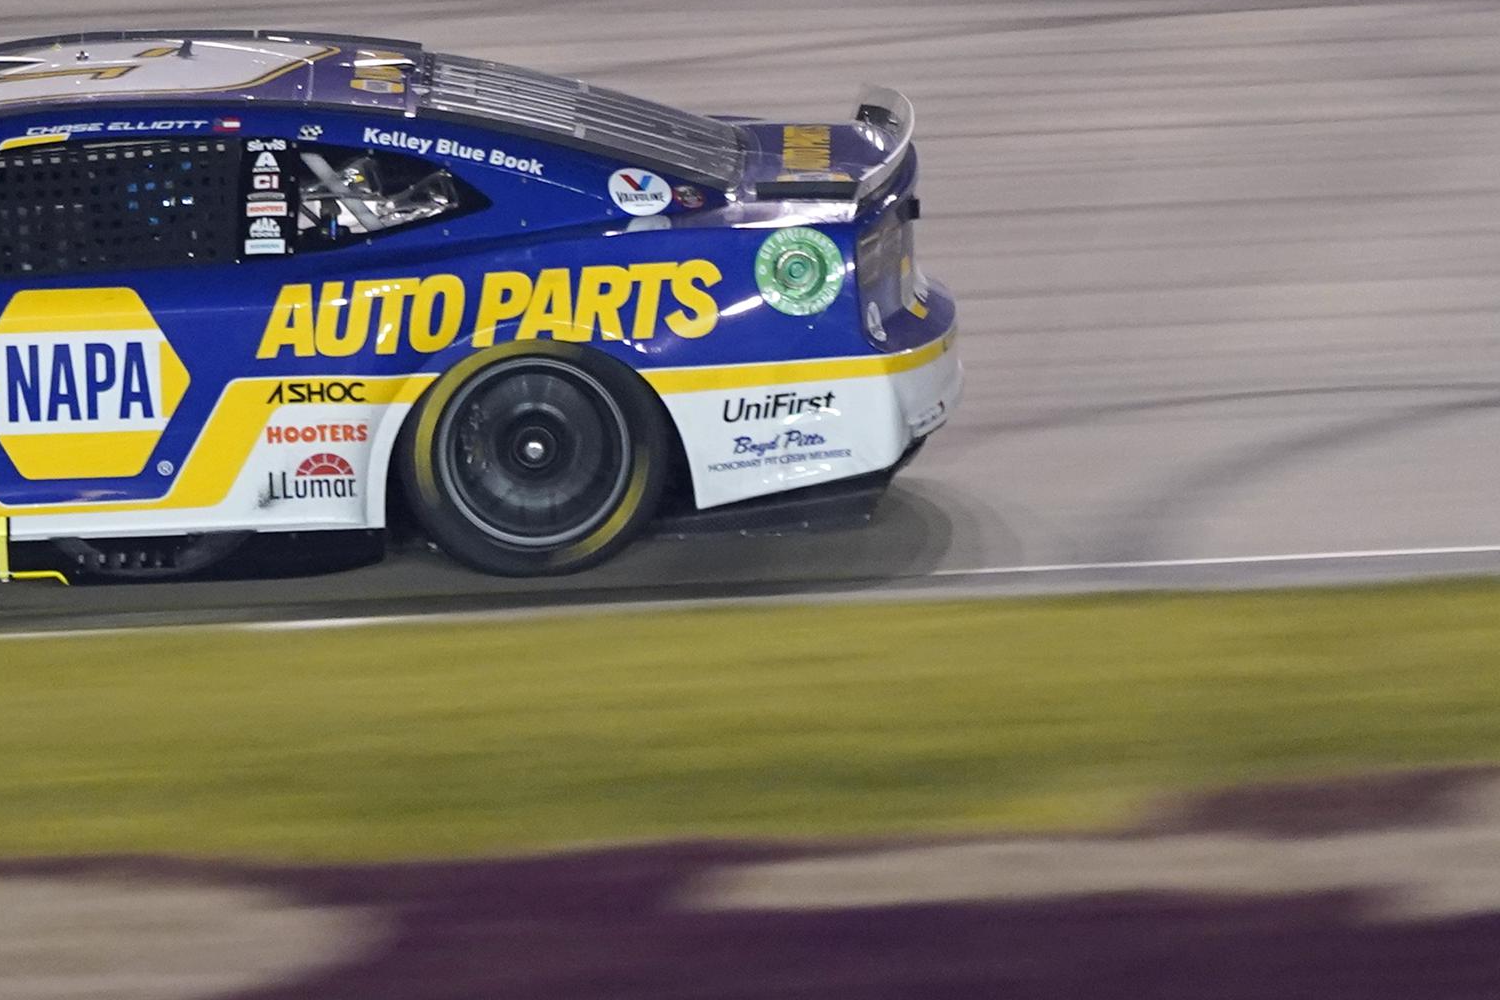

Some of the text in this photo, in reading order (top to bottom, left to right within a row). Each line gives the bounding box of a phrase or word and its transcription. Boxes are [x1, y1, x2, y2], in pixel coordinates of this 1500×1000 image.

[26, 119, 209, 137] CHASE ELLIOTT
[363, 127, 545, 176] Kelley Blue Book
[256, 274, 466, 359] AUTO
[471, 259, 723, 348] PARTS
[6, 341, 155, 423] NAPA
[266, 381, 368, 404] ASHOC
[723, 391, 836, 423] UniFirst
[266, 424, 368, 444] HOOTERS
